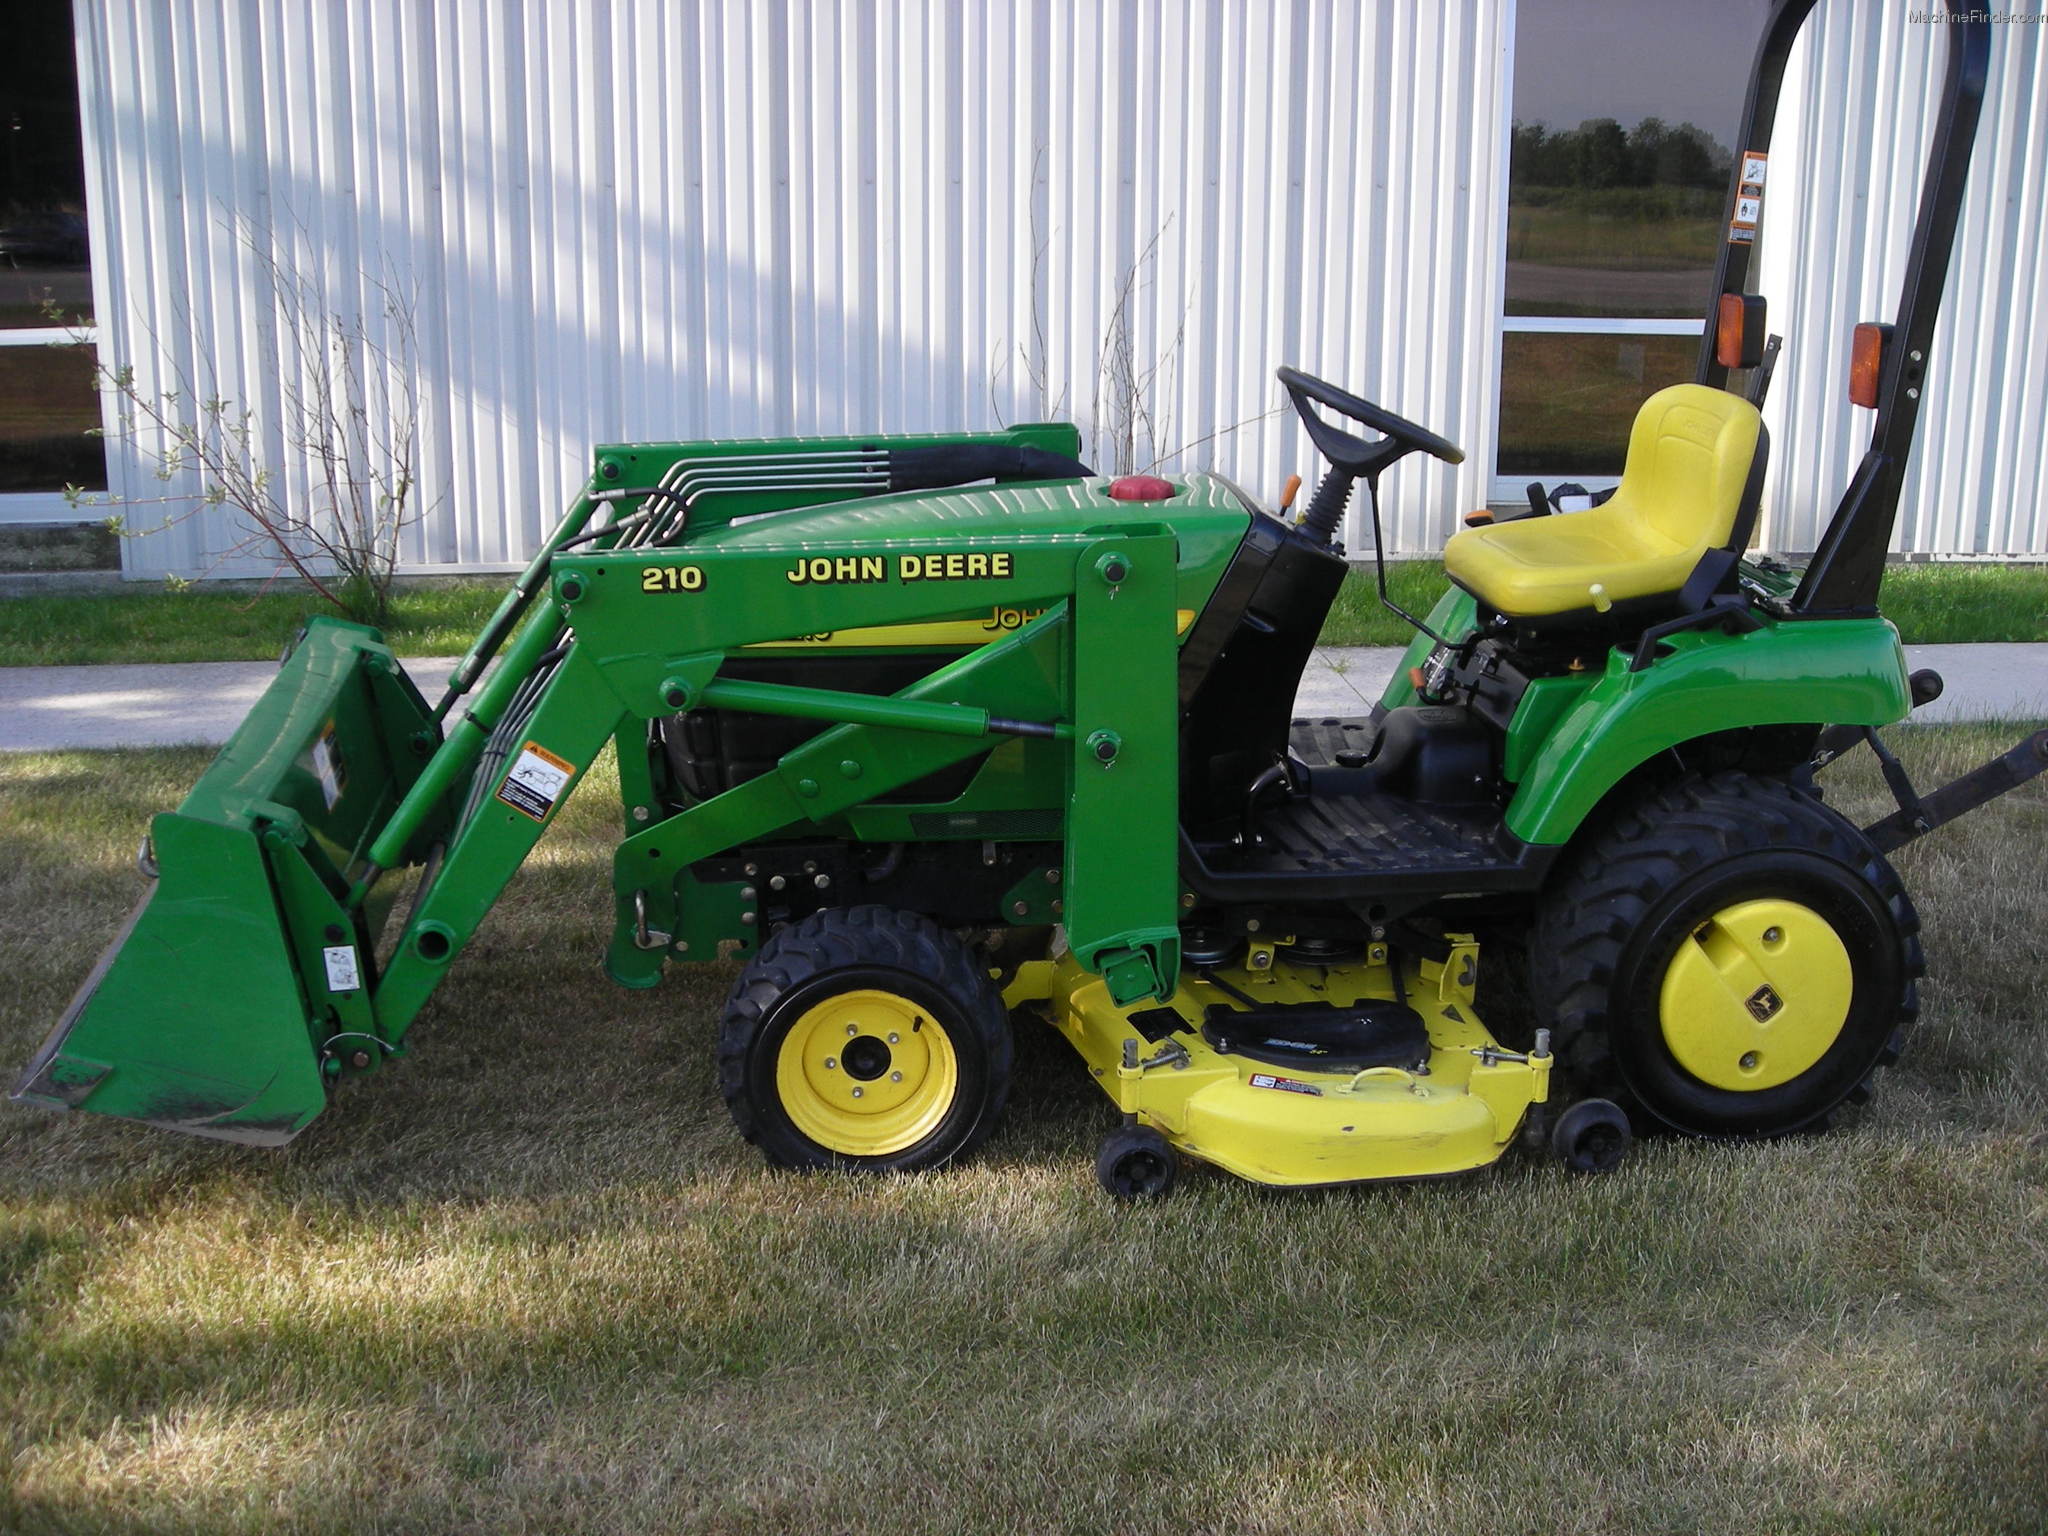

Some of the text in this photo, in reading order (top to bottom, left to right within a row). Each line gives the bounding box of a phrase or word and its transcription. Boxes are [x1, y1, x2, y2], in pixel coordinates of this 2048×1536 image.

[642, 566, 706, 592] 210
[786, 553, 1012, 584] JOHN DEERE
[983, 606, 1049, 630] JOH
